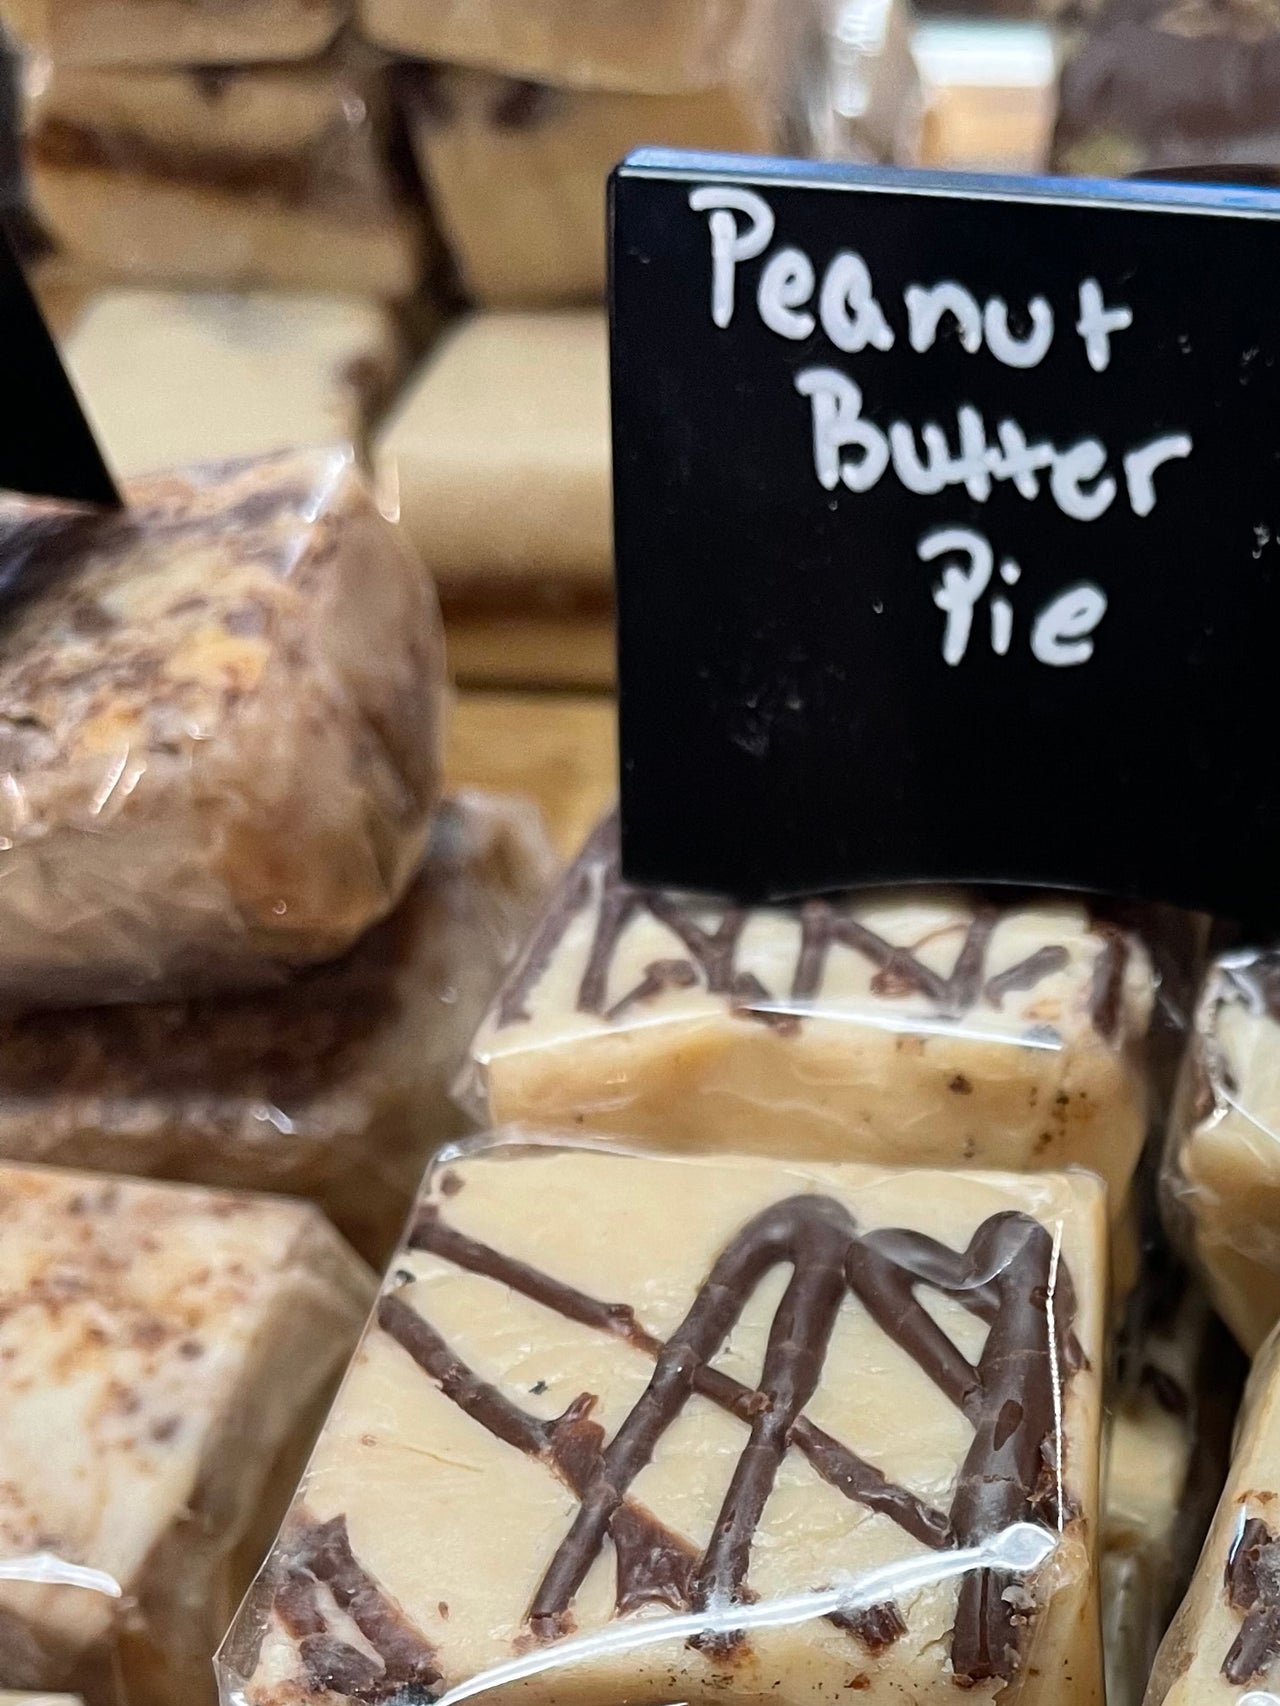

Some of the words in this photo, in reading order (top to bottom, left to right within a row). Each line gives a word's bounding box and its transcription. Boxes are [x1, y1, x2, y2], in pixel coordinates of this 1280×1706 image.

[688, 185, 1133, 372] Peanut
[795, 368, 1193, 521] Butter
[918, 528, 1107, 666] Pie
